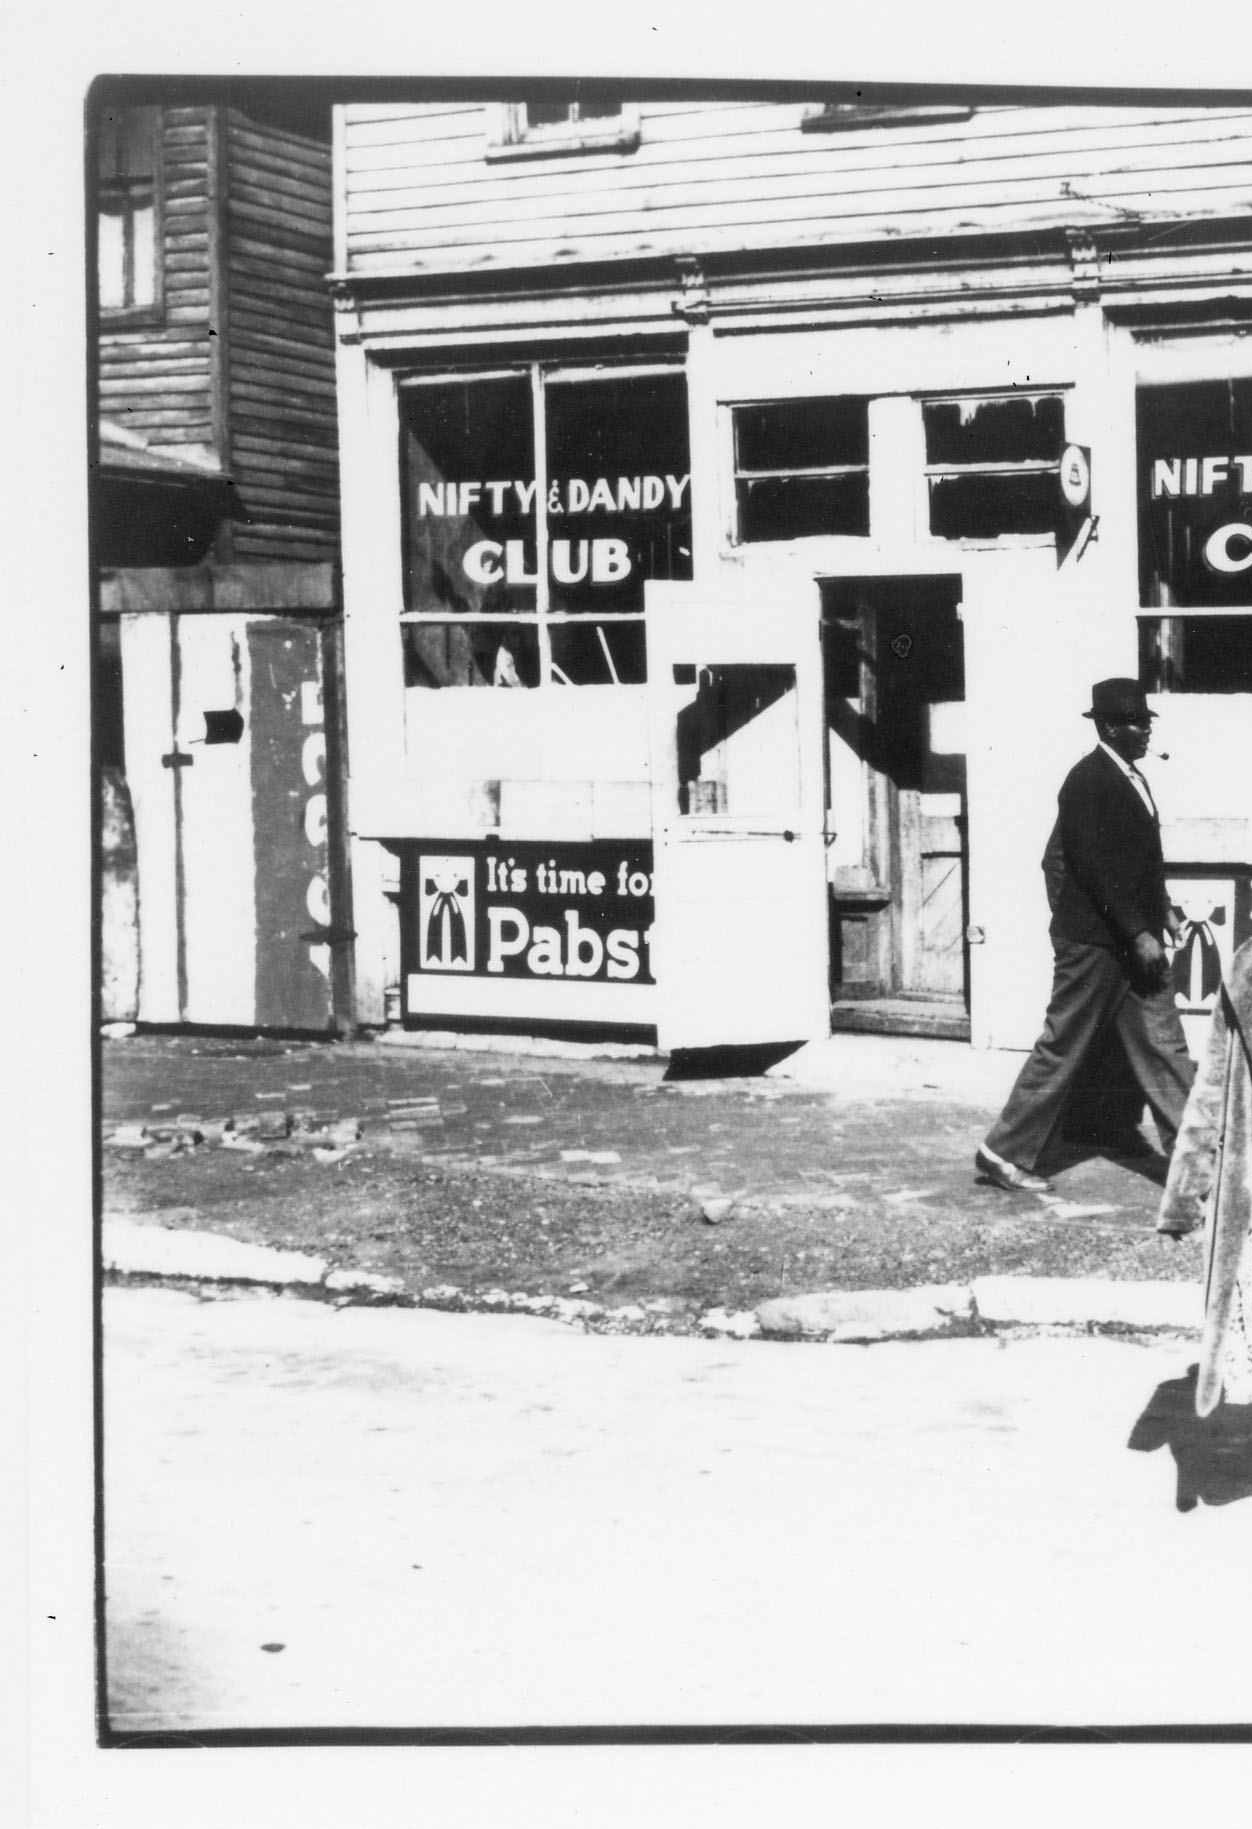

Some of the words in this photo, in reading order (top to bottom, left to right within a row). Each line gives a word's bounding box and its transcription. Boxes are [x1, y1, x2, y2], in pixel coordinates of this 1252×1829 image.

[419, 481, 538, 517] NIFTY
[546, 479, 564, 514] &
[568, 474, 691, 513] DANDY
[462, 538, 632, 585] CLUB
[486, 856, 528, 893] It's
[537, 860, 607, 895] time
